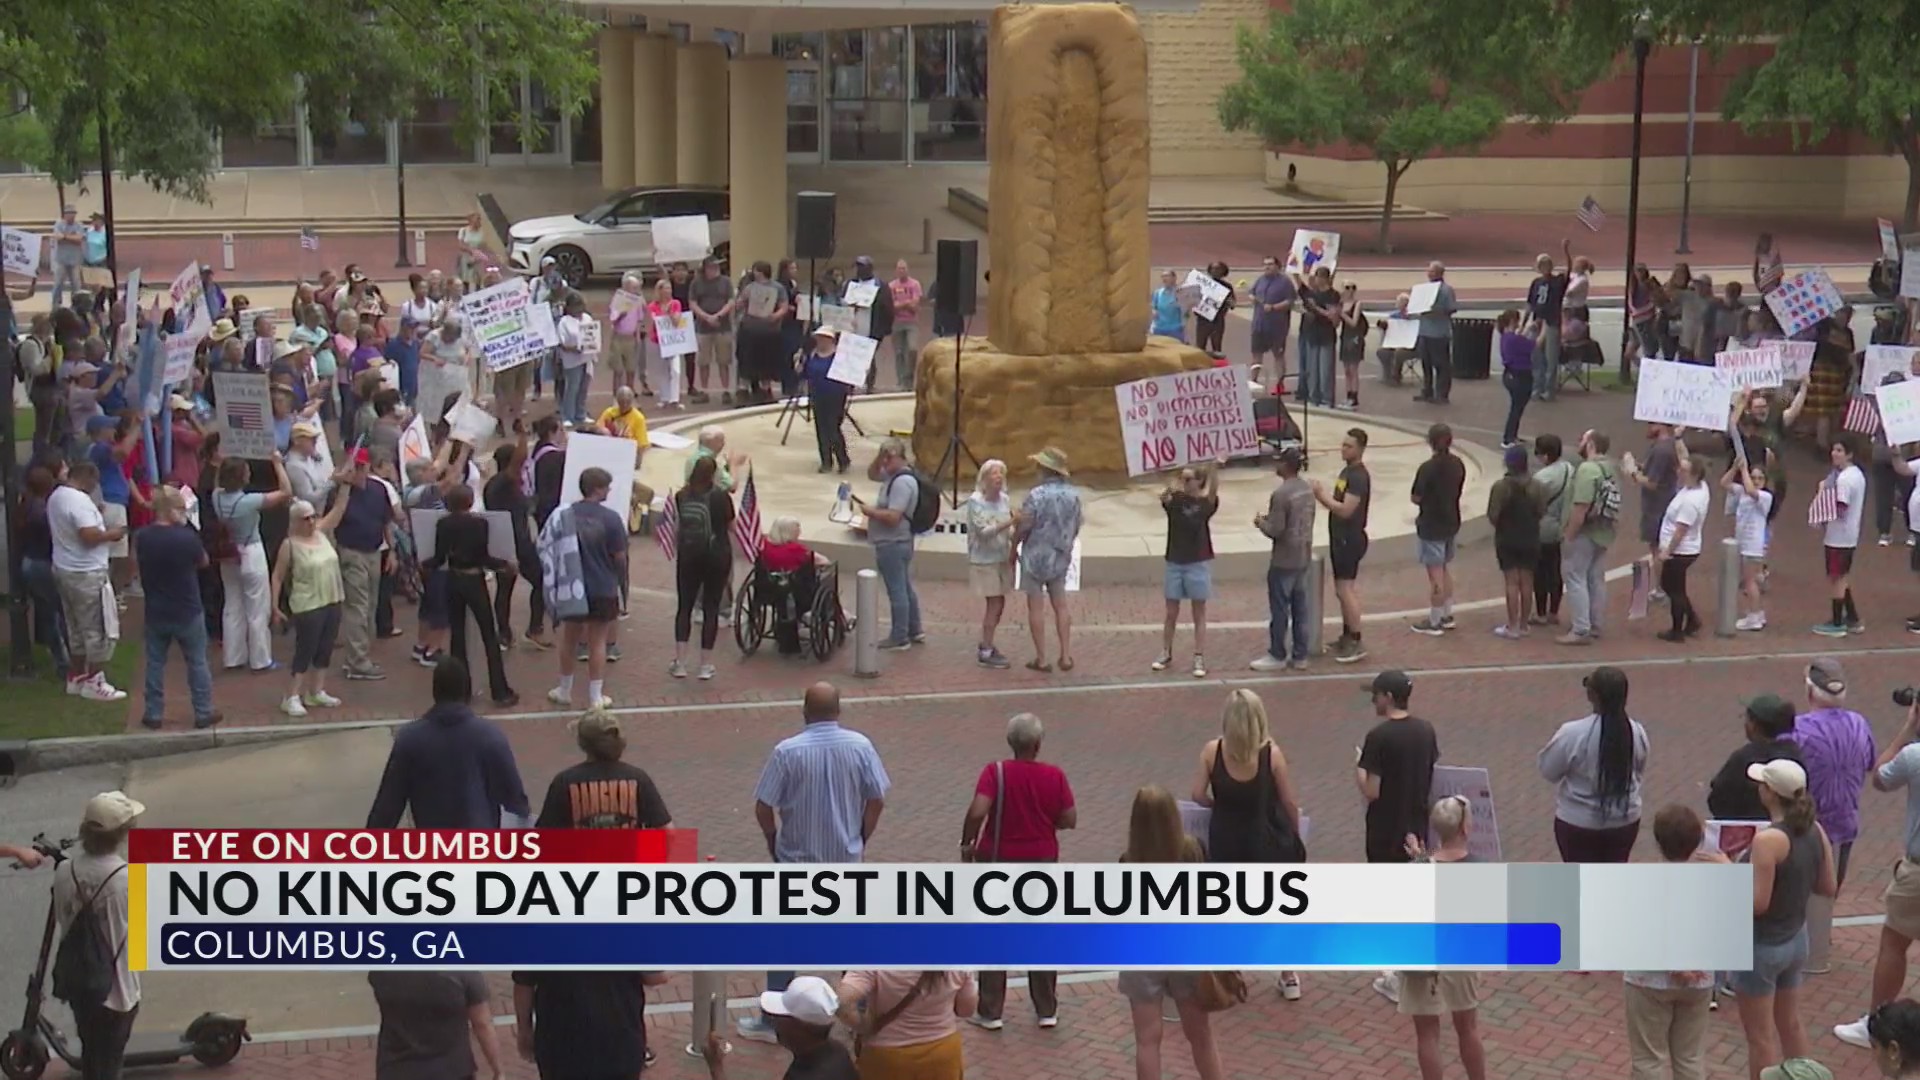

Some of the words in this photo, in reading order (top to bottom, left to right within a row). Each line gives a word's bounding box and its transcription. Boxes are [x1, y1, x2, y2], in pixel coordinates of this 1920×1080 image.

[1131, 380, 1158, 400] NO
[1174, 369, 1237, 394] KINGS!
[1126, 404, 1149, 420] NO
[1157, 390, 1239, 414] DICTATORS!
[1145, 418, 1168, 434] NO
[1174, 407, 1243, 429] FASCISTS!
[1142, 436, 1176, 471] NO
